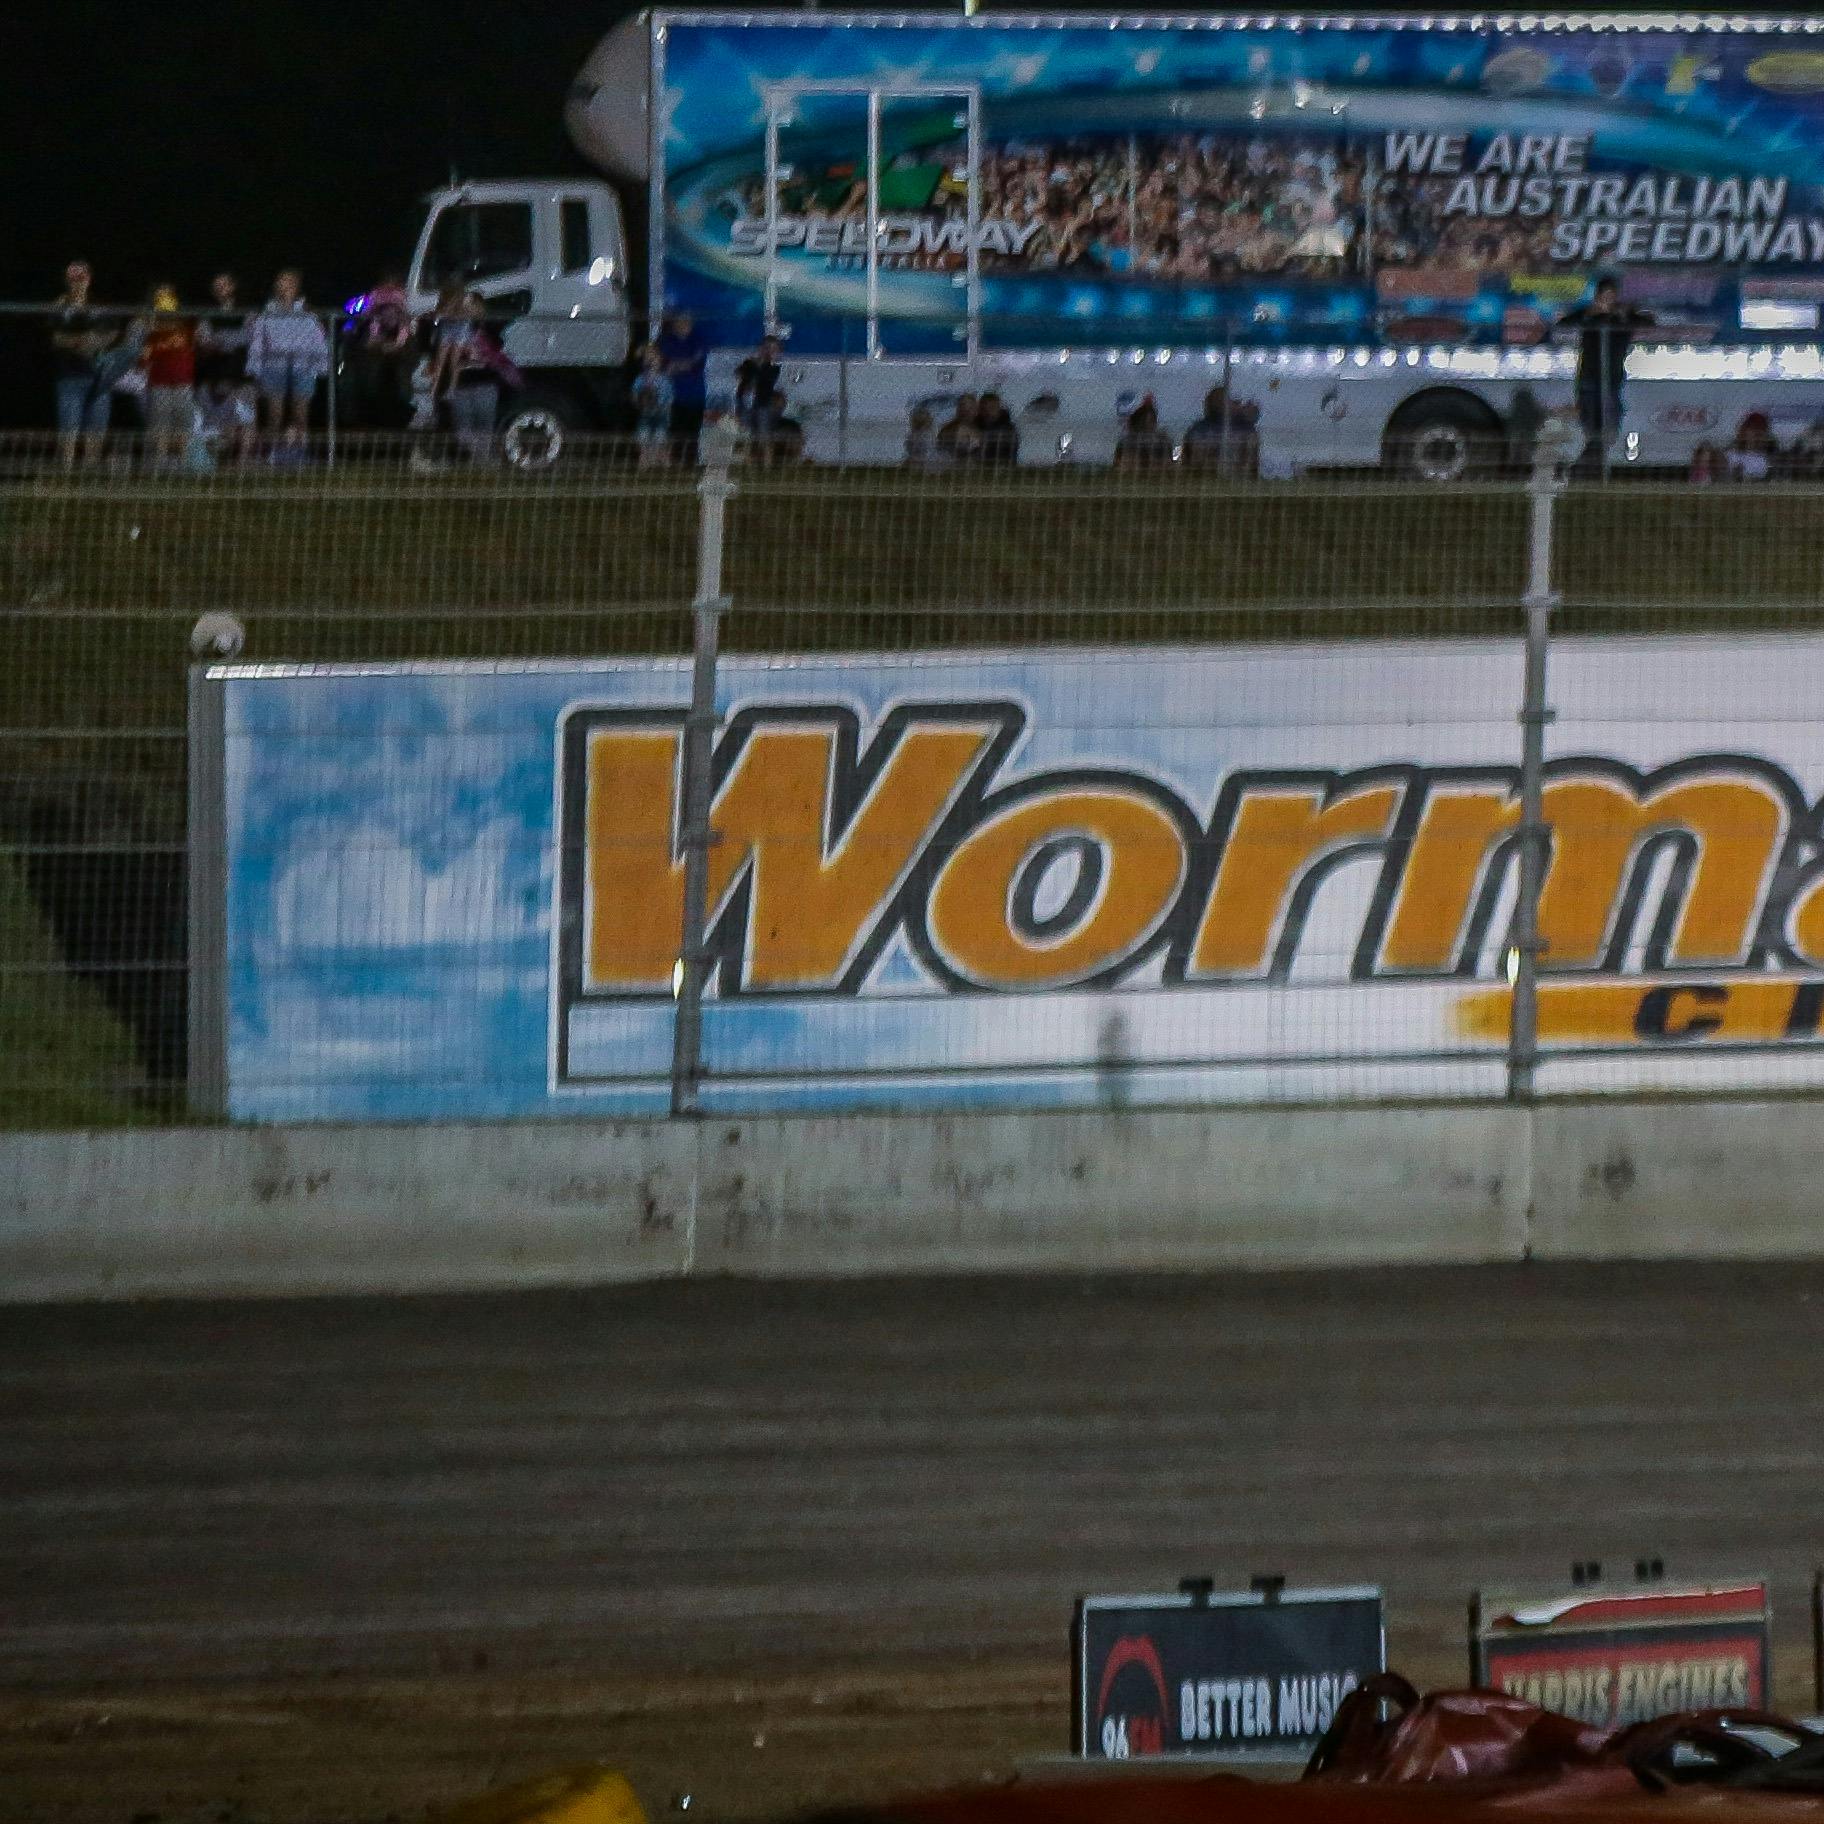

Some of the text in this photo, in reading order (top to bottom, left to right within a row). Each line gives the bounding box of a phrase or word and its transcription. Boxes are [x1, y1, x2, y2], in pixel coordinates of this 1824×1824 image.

[1385, 132, 1594, 174] WE ARE
[1441, 176, 1788, 218] AUSTRALIAN
[1180, 1677, 1272, 1741] BETTER
